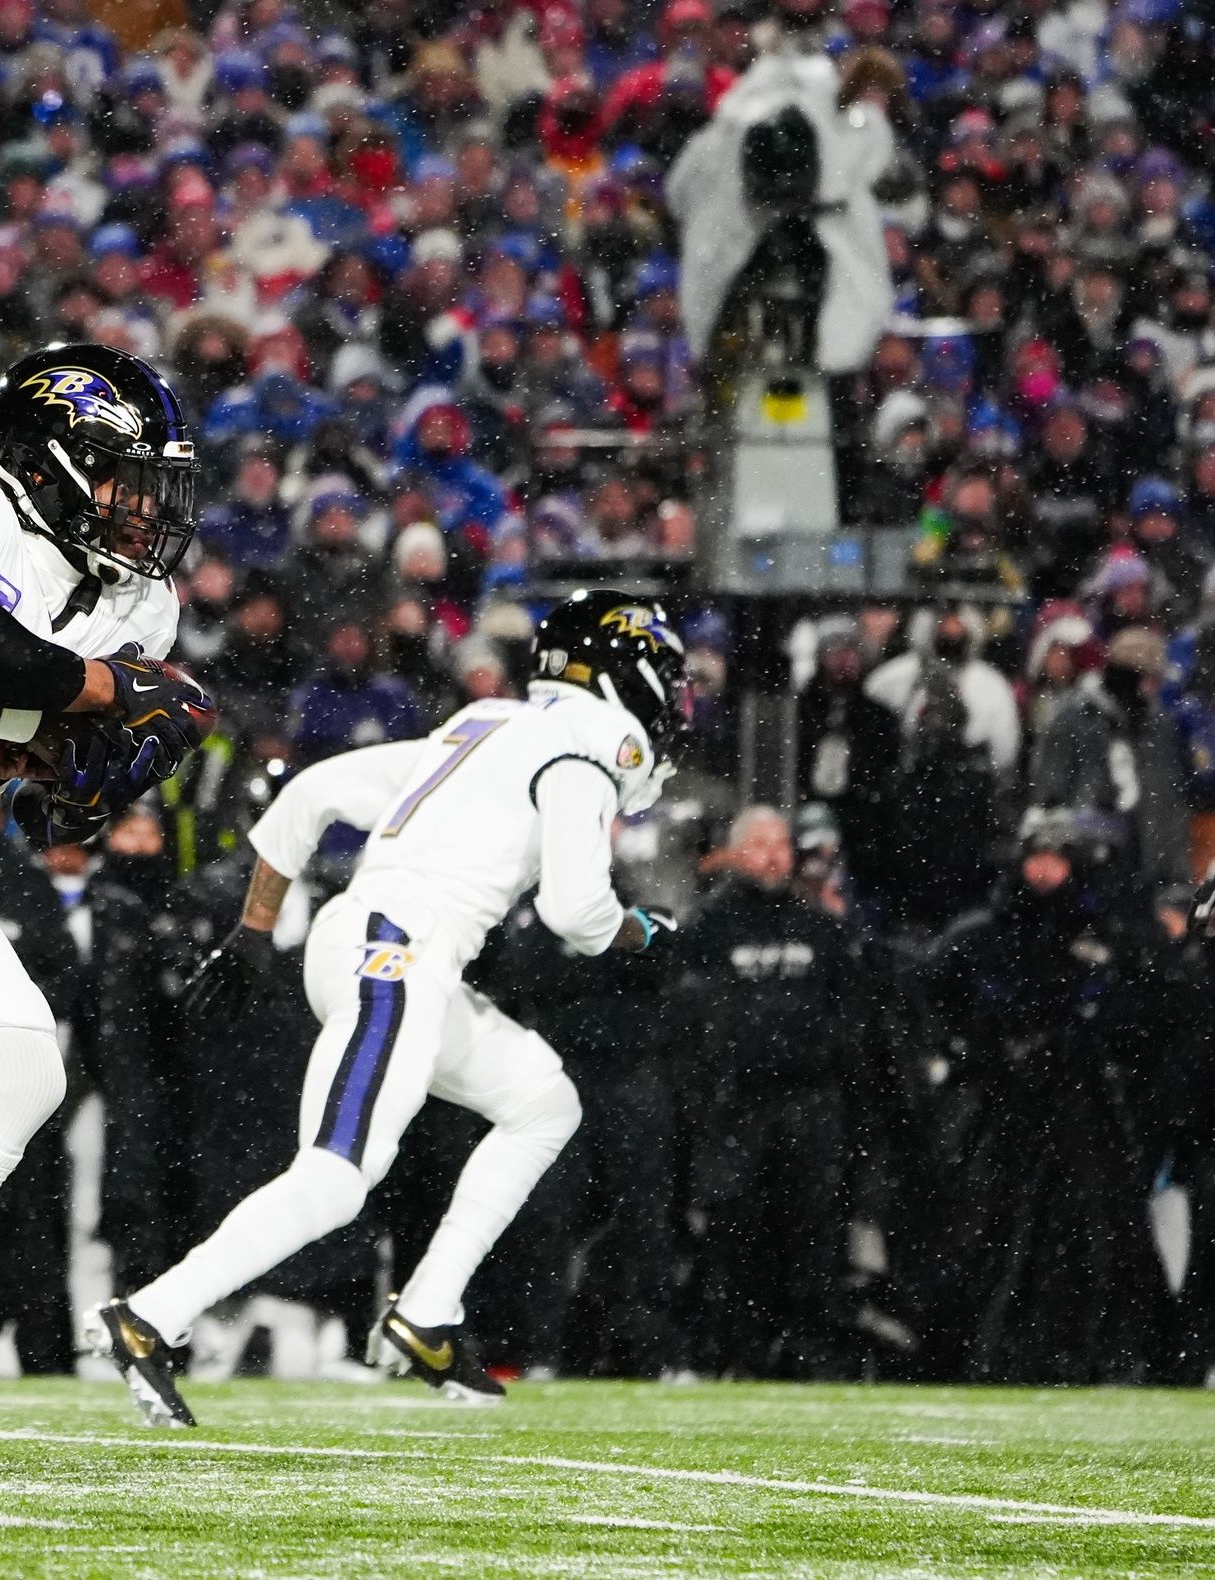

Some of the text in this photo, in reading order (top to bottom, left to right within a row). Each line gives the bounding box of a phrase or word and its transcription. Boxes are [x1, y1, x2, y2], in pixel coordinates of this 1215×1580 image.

[49, 370, 94, 394] B
[538, 649, 549, 673] 7
[380, 717, 510, 840] 7
[353, 941, 418, 982] B
